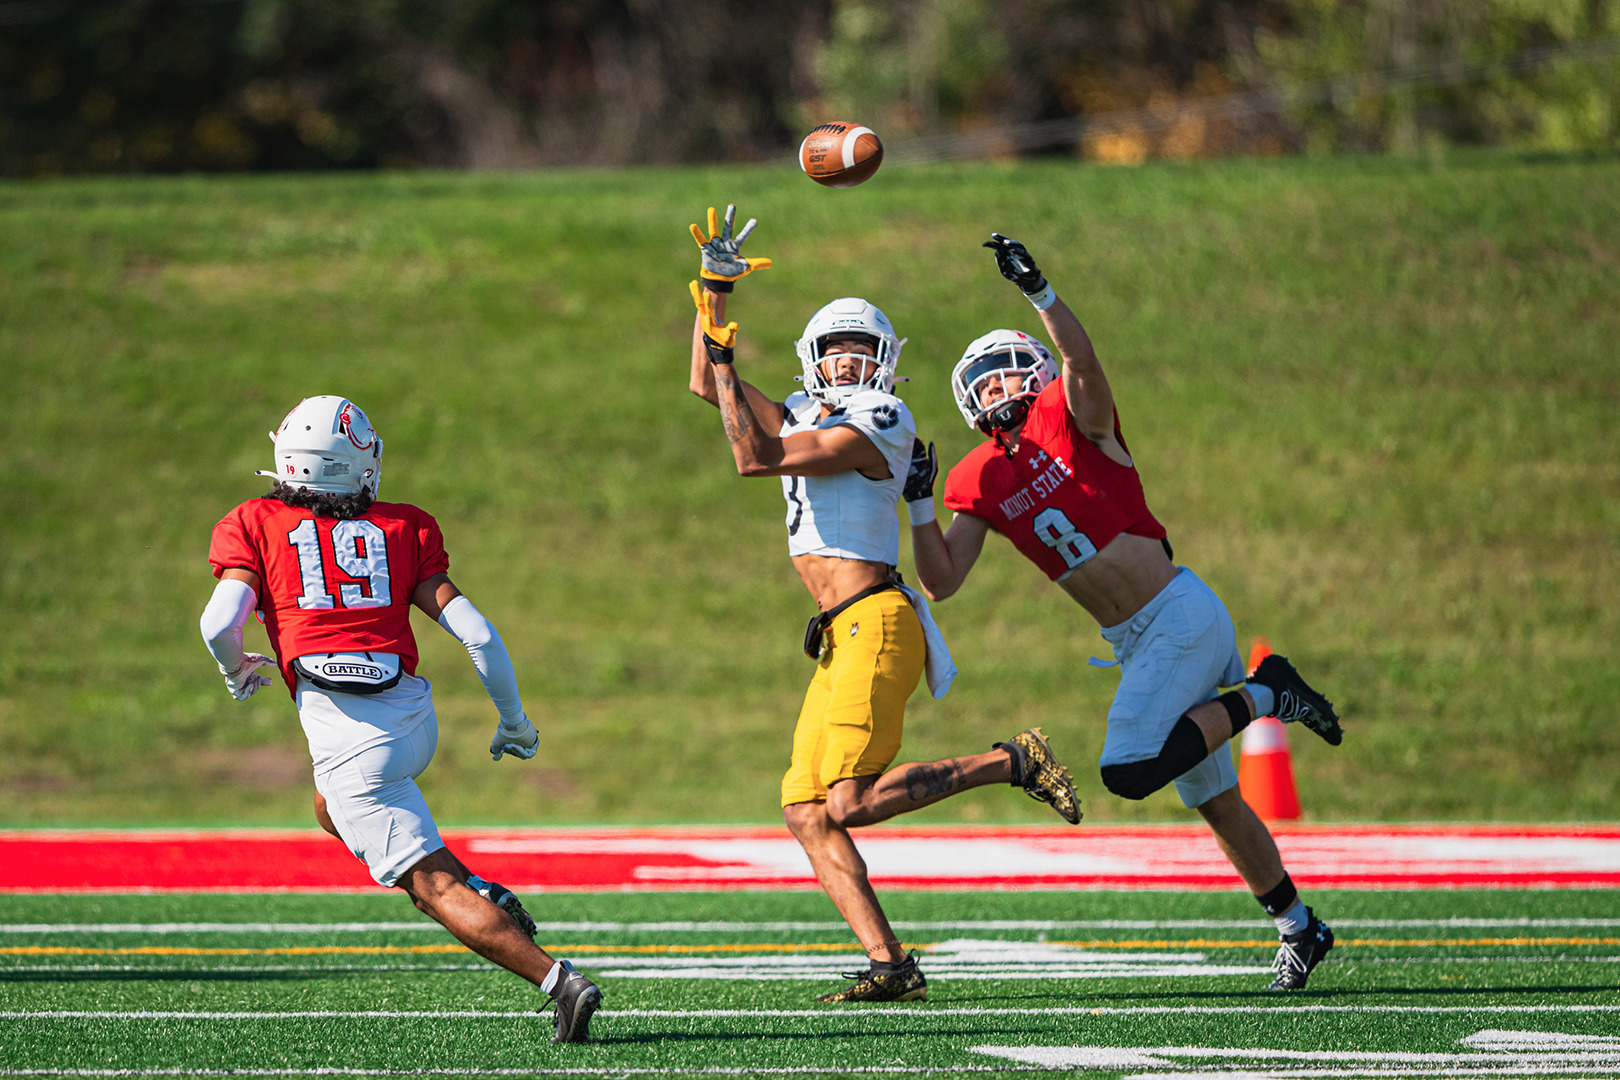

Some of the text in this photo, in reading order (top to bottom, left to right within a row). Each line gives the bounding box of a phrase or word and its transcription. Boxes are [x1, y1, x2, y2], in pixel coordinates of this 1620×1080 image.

[809, 154, 827, 163] GST
[285, 464, 296, 475] 19
[999, 456, 1072, 521] MINOT STATE
[1033, 507, 1098, 570] 8
[288, 519, 392, 609] 19
[327, 664, 379, 678] BATTLE
